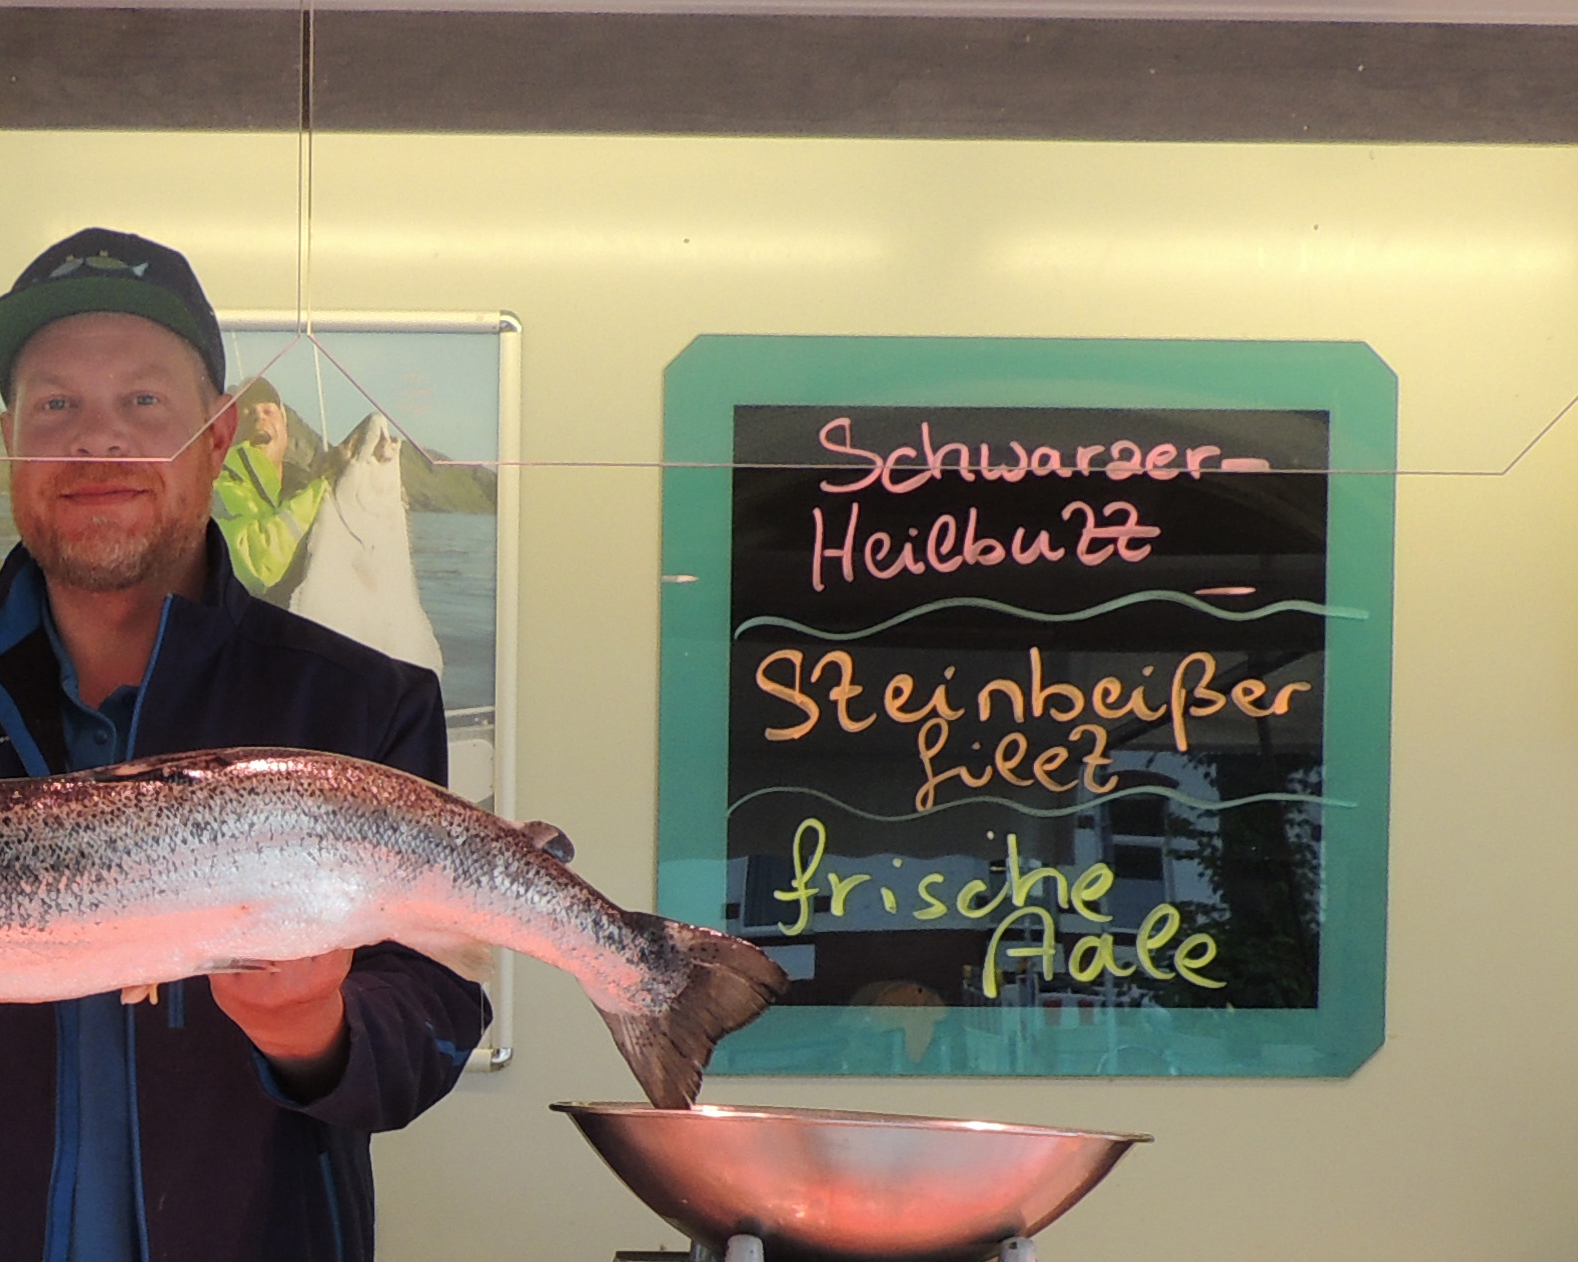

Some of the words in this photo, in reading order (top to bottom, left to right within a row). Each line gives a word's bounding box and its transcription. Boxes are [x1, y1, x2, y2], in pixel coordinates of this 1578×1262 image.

[755, 648, 1311, 751] Steinbeißer
[774, 818, 1114, 936] frische
[983, 906, 1227, 998] Aale
